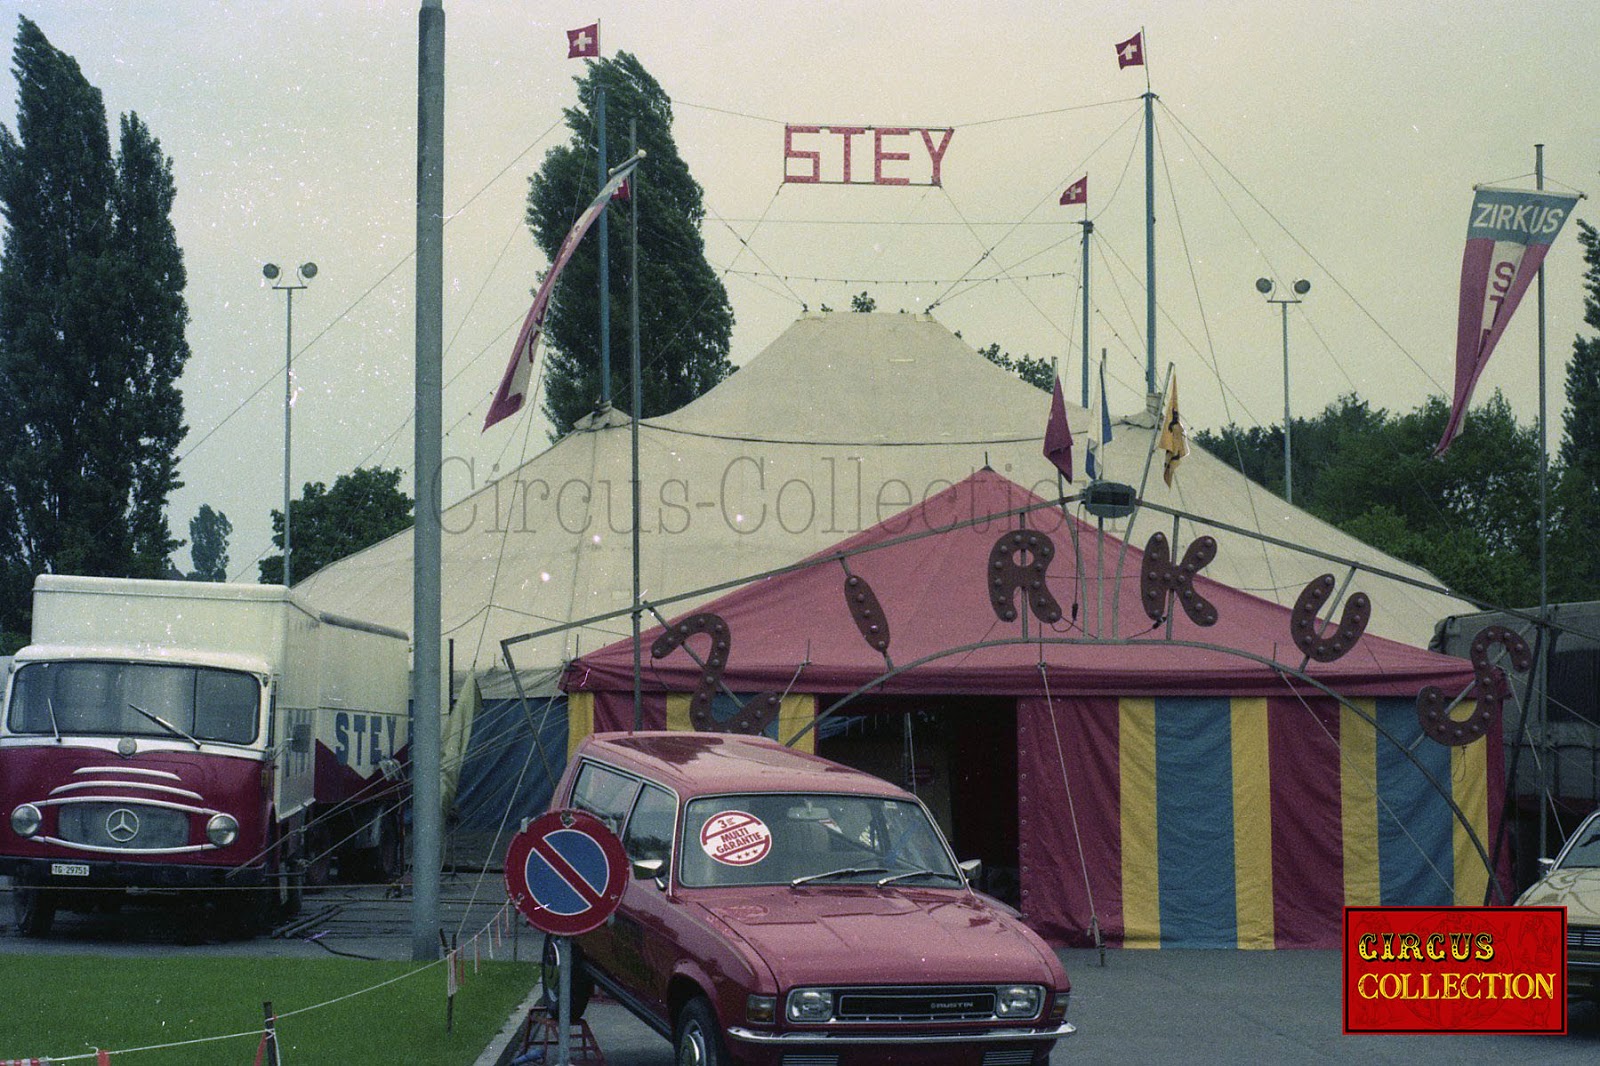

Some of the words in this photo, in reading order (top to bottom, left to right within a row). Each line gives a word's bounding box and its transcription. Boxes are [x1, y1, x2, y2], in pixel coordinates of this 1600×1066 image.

[784, 126, 955, 186] STEY
[1472, 202, 1564, 234] ZIRKUS
[651, 529, 1531, 746] ZIRKUS
[335, 712, 397, 766] STEY
[716, 831, 763, 853] GARANTIE
[720, 827, 749, 843] MULTI
